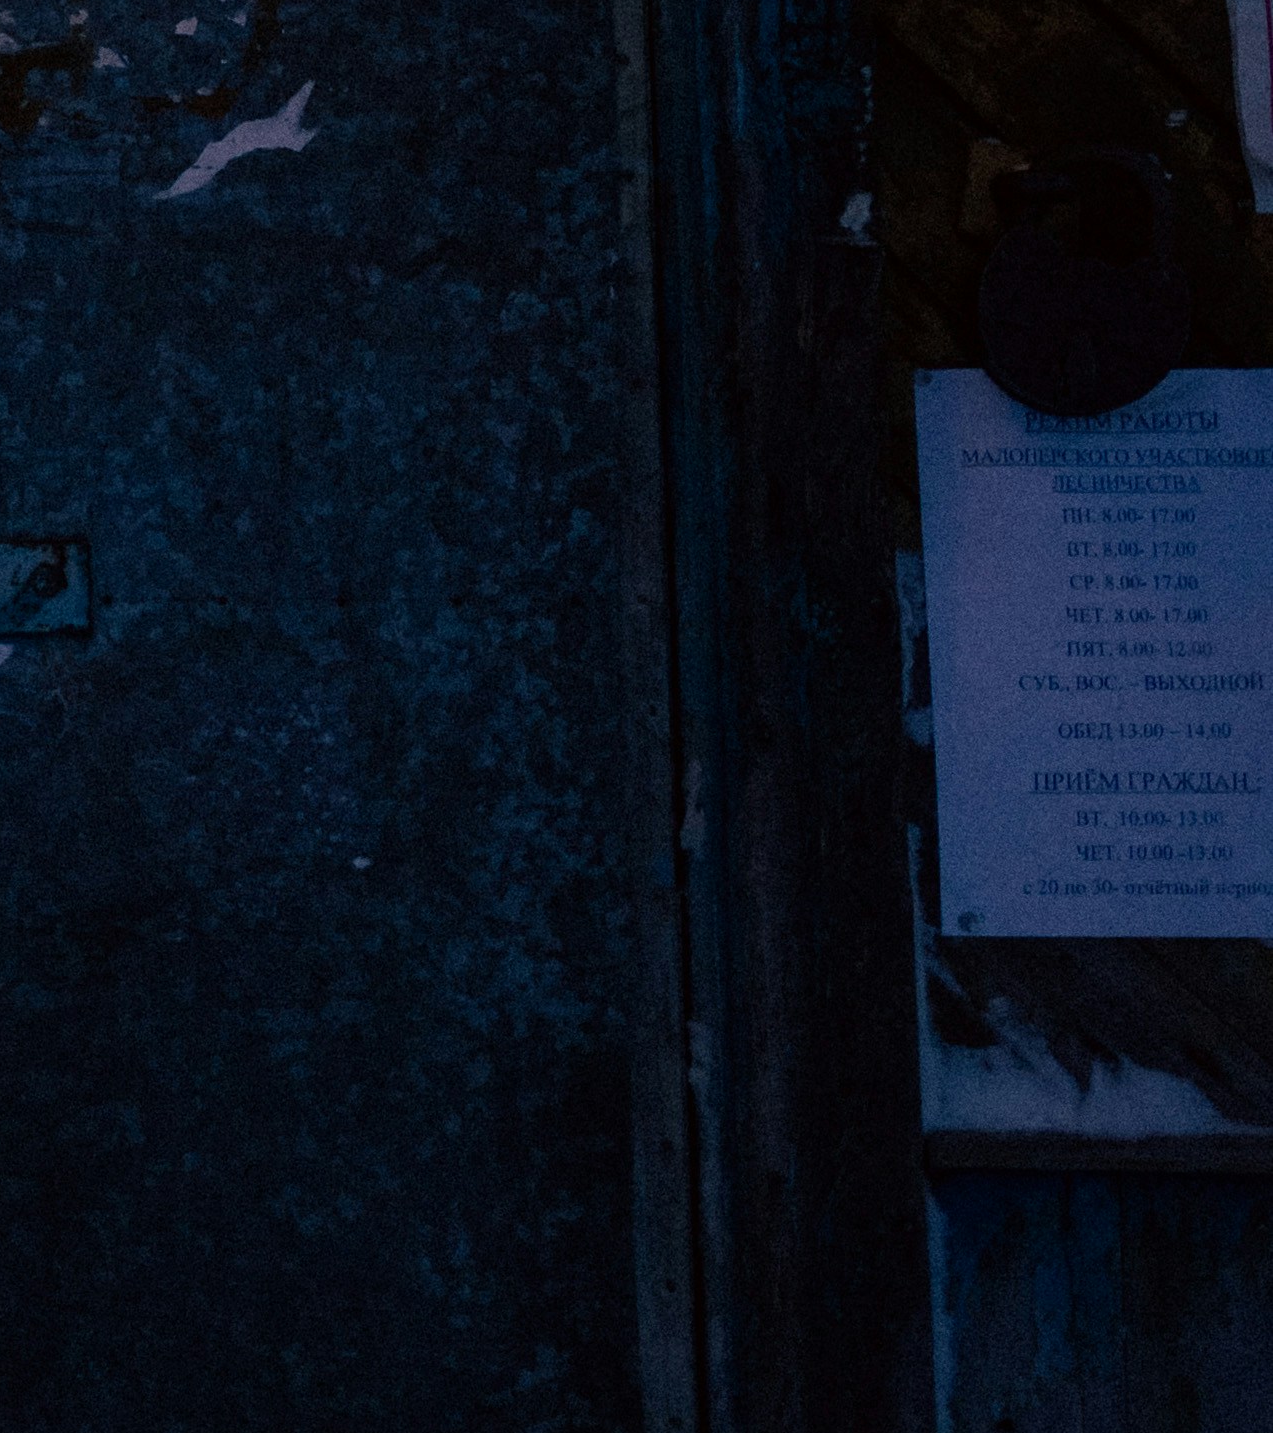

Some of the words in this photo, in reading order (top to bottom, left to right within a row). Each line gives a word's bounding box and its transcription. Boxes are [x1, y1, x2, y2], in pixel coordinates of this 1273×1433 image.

[1119, 411, 1219, 431] РАБОТЫ
[1136, 448, 1273, 466] УЧАСТКОВОГ
[1055, 474, 1201, 491] ЛЕСНИЧЕСТВА
[1144, 671, 1265, 692] ВЫХОДНОЙ
[1058, 722, 1114, 741] ОБЕД
[1033, 769, 1120, 791] ПРИЁМ
